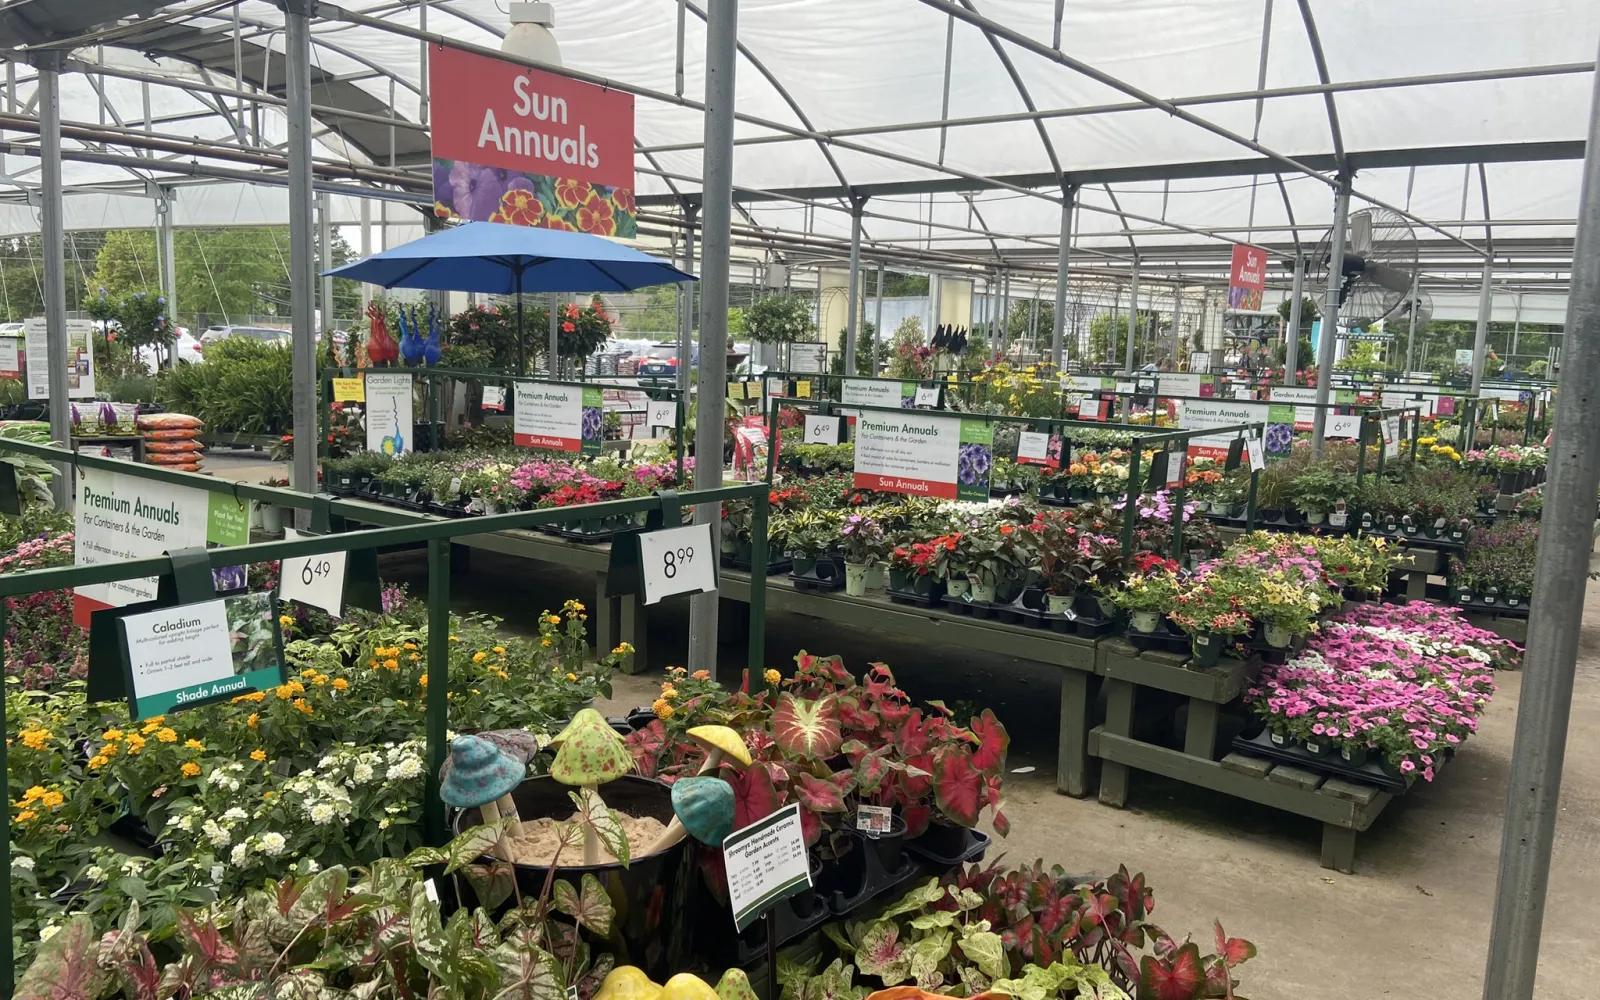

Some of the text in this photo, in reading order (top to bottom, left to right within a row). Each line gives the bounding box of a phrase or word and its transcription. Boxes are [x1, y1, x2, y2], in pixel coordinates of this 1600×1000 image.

[513, 75, 568, 124] Sun
[478, 108, 599, 168] Annuals
[1246, 251, 1257, 268] Sun
[1239, 265, 1260, 284] Annuals
[367, 376, 410, 386] Garden Lights
[518, 390, 568, 402] Premium Annuals
[1185, 407, 1250, 418] Premium Annuals
[861, 420, 938, 436] Premium Annuals
[531, 436, 563, 446] Sun Annuals
[869, 433, 894, 442] Containers
[879, 477, 928, 492] Sun Annuals
[84, 486, 179, 525] Premium Annuals
[84, 512, 164, 542] For Containers & the Garden
[136, 624, 219, 644] Multi-colored upright foliage perfect
[152, 618, 201, 634] Caladium
[167, 636, 184, 644] adding
[161, 657, 176, 665] partial
[176, 677, 247, 703] Shade Annual
[751, 828, 775, 846] Handmade
[776, 819, 794, 832] Ceramic
[745, 845, 762, 858] Garden
[763, 836, 779, 849] Accents
